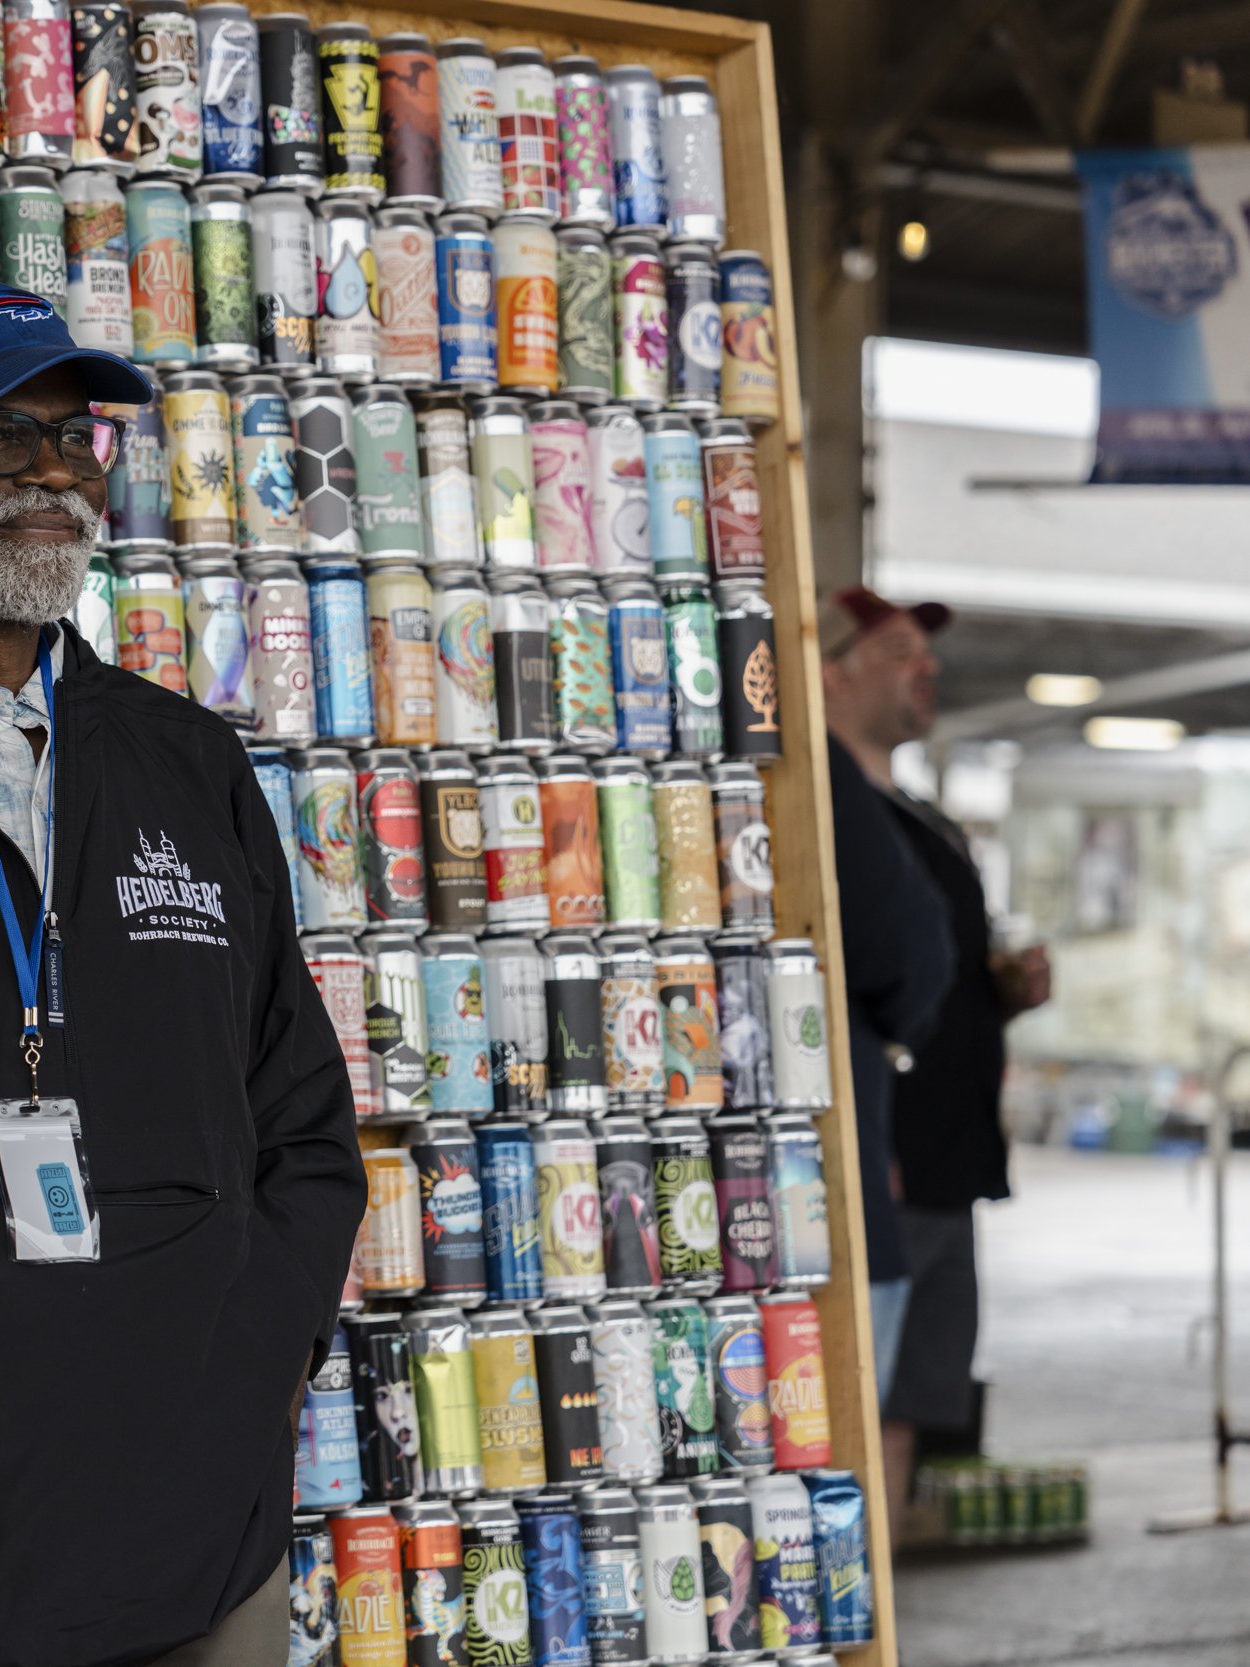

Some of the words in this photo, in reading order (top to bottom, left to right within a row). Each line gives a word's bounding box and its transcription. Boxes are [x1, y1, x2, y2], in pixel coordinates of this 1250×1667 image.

[116, 876, 226, 923] HEIDELBERG
[149, 915, 208, 929] SOCIETY
[129, 930, 180, 940] ROHRBACH
[182, 932, 216, 944] BREWING
